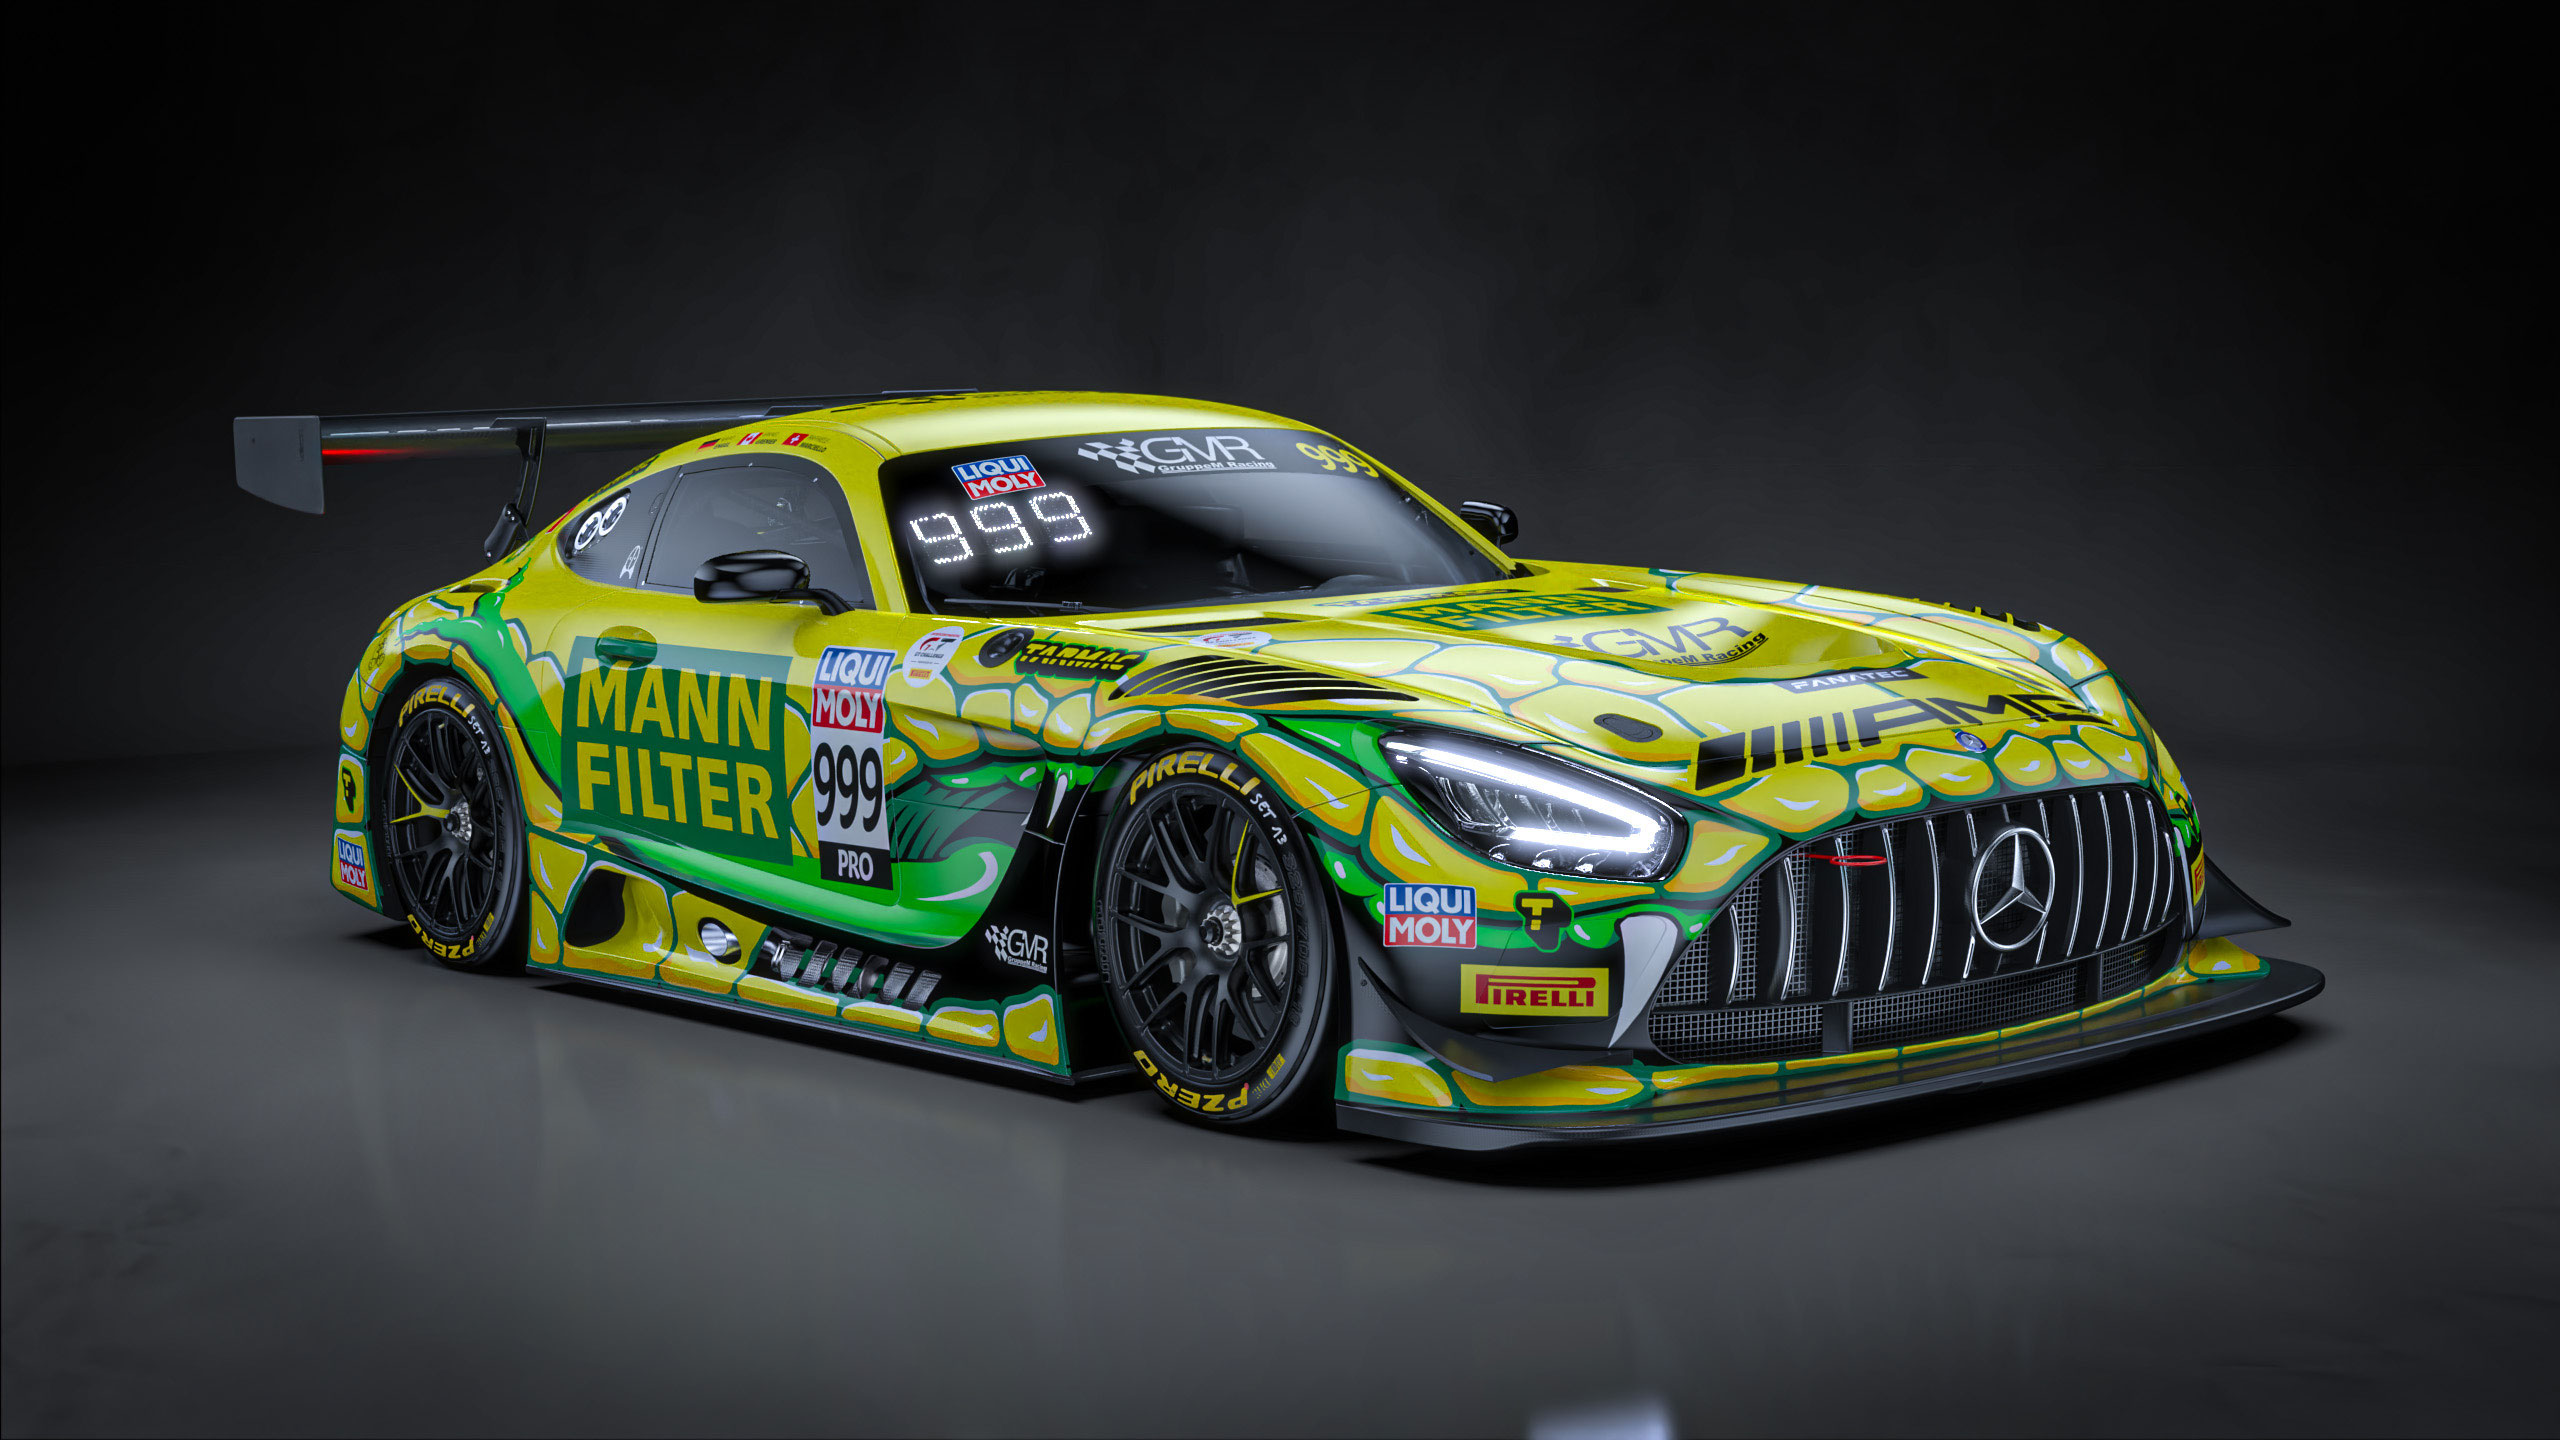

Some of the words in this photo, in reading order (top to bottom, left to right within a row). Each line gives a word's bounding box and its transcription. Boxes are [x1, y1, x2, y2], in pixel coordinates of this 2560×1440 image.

[957, 455, 1031, 482] LIQUI
[1158, 462, 1223, 472] GruppeM
[1228, 459, 1276, 470] Racing
[1295, 442, 1379, 478] 999
[973, 467, 1044, 497] MOLY
[910, 491, 1093, 565] 999
[1394, 594, 1597, 618] MANN
[1439, 601, 1652, 628] FILTER
[1704, 632, 1766, 662] Racing
[817, 649, 891, 687] LIQUI
[1790, 669, 1910, 690] FANATEC
[398, 684, 476, 728] PIRELLI
[576, 657, 772, 751] MANN
[815, 686, 883, 730] MOLY
[467, 715, 484, 736] SET
[1852, 694, 2115, 748] AMG
[576, 741, 779, 839] FILTER
[813, 742, 883, 832] 999
[1130, 750, 1261, 805] PIRELLI
[1250, 793, 1277, 819] SET
[337, 837, 363, 862] LIQUI
[340, 863, 367, 890] MOLY
[837, 849, 874, 881] PRO
[1389, 886, 1472, 915] LIQUI
[1389, 916, 1475, 945] MOLY
[1475, 973, 1596, 1007] PIRELLI
